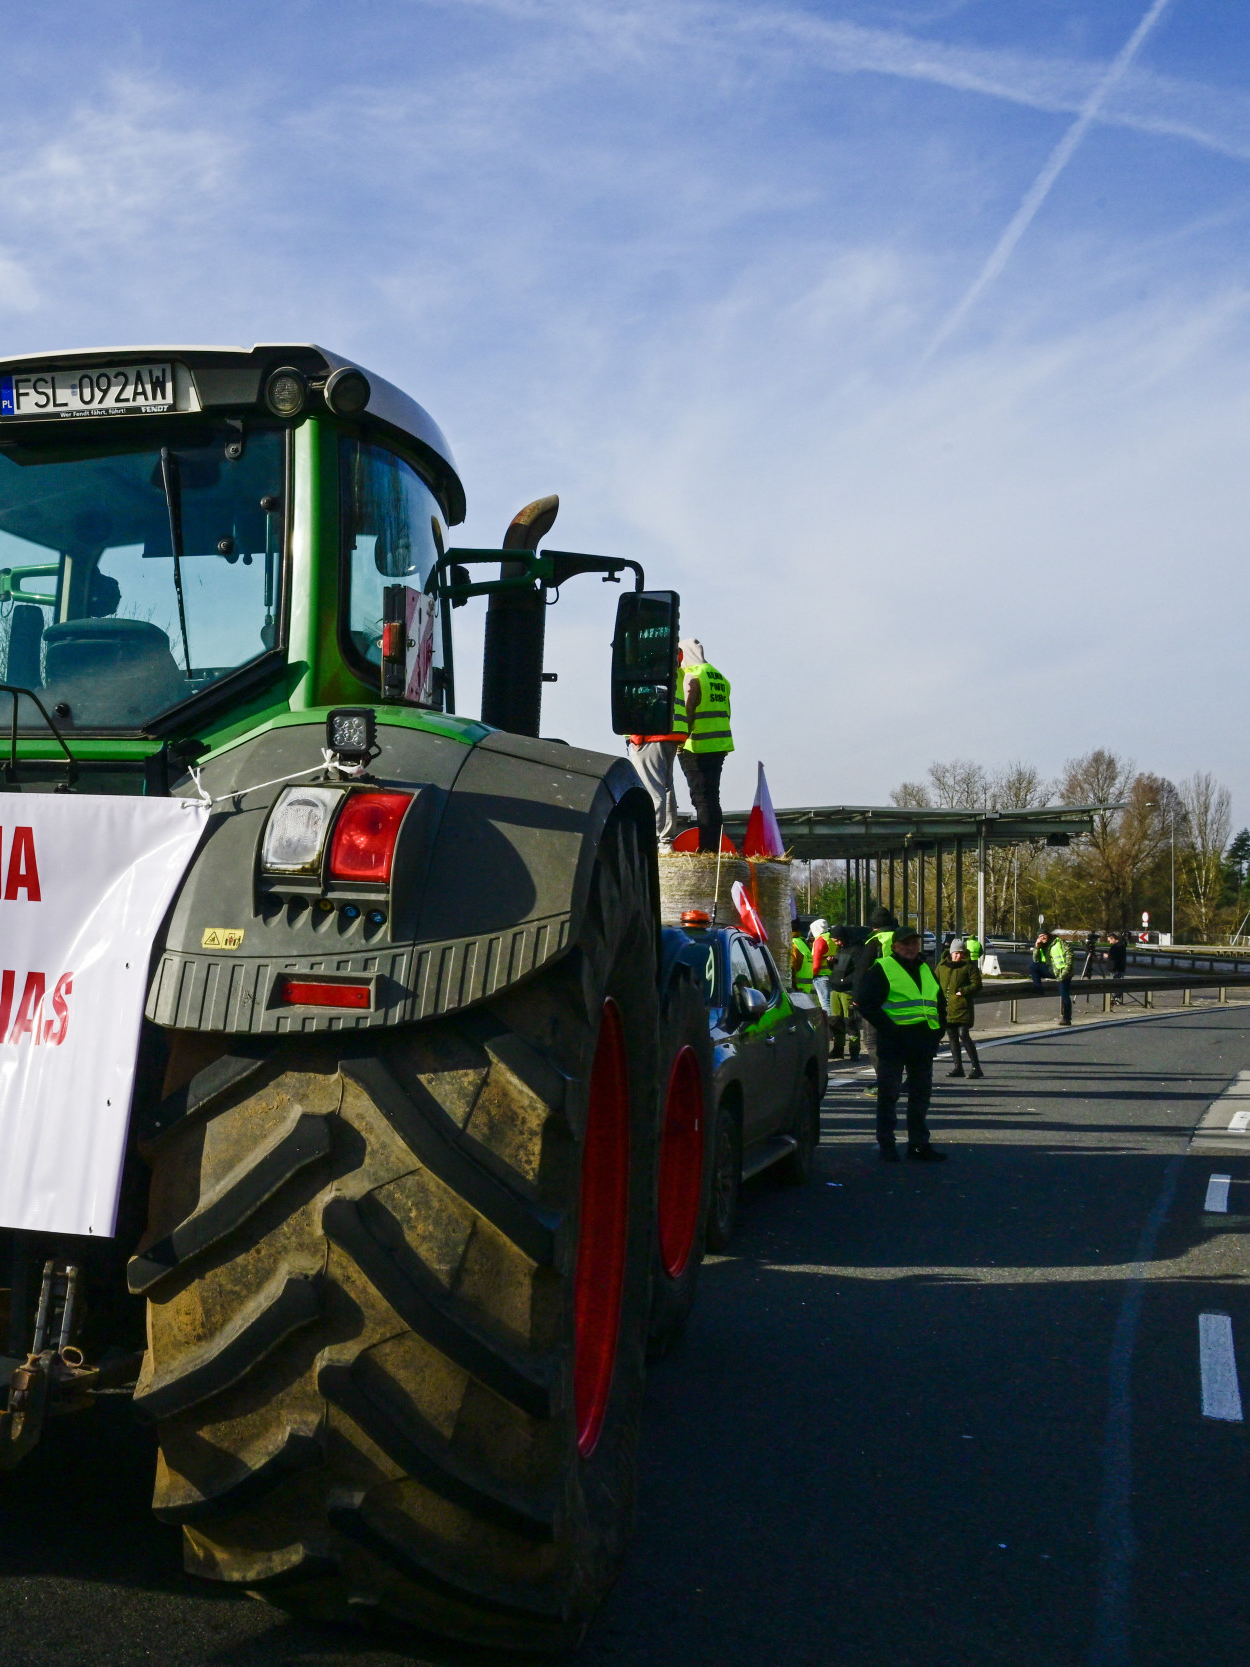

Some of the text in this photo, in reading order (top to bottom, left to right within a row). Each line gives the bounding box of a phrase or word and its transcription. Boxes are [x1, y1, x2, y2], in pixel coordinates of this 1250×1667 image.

[14, 367, 167, 411] FSL 092AW
[2, 400, 13, 409] PL
[140, 405, 169, 413] FENDT
